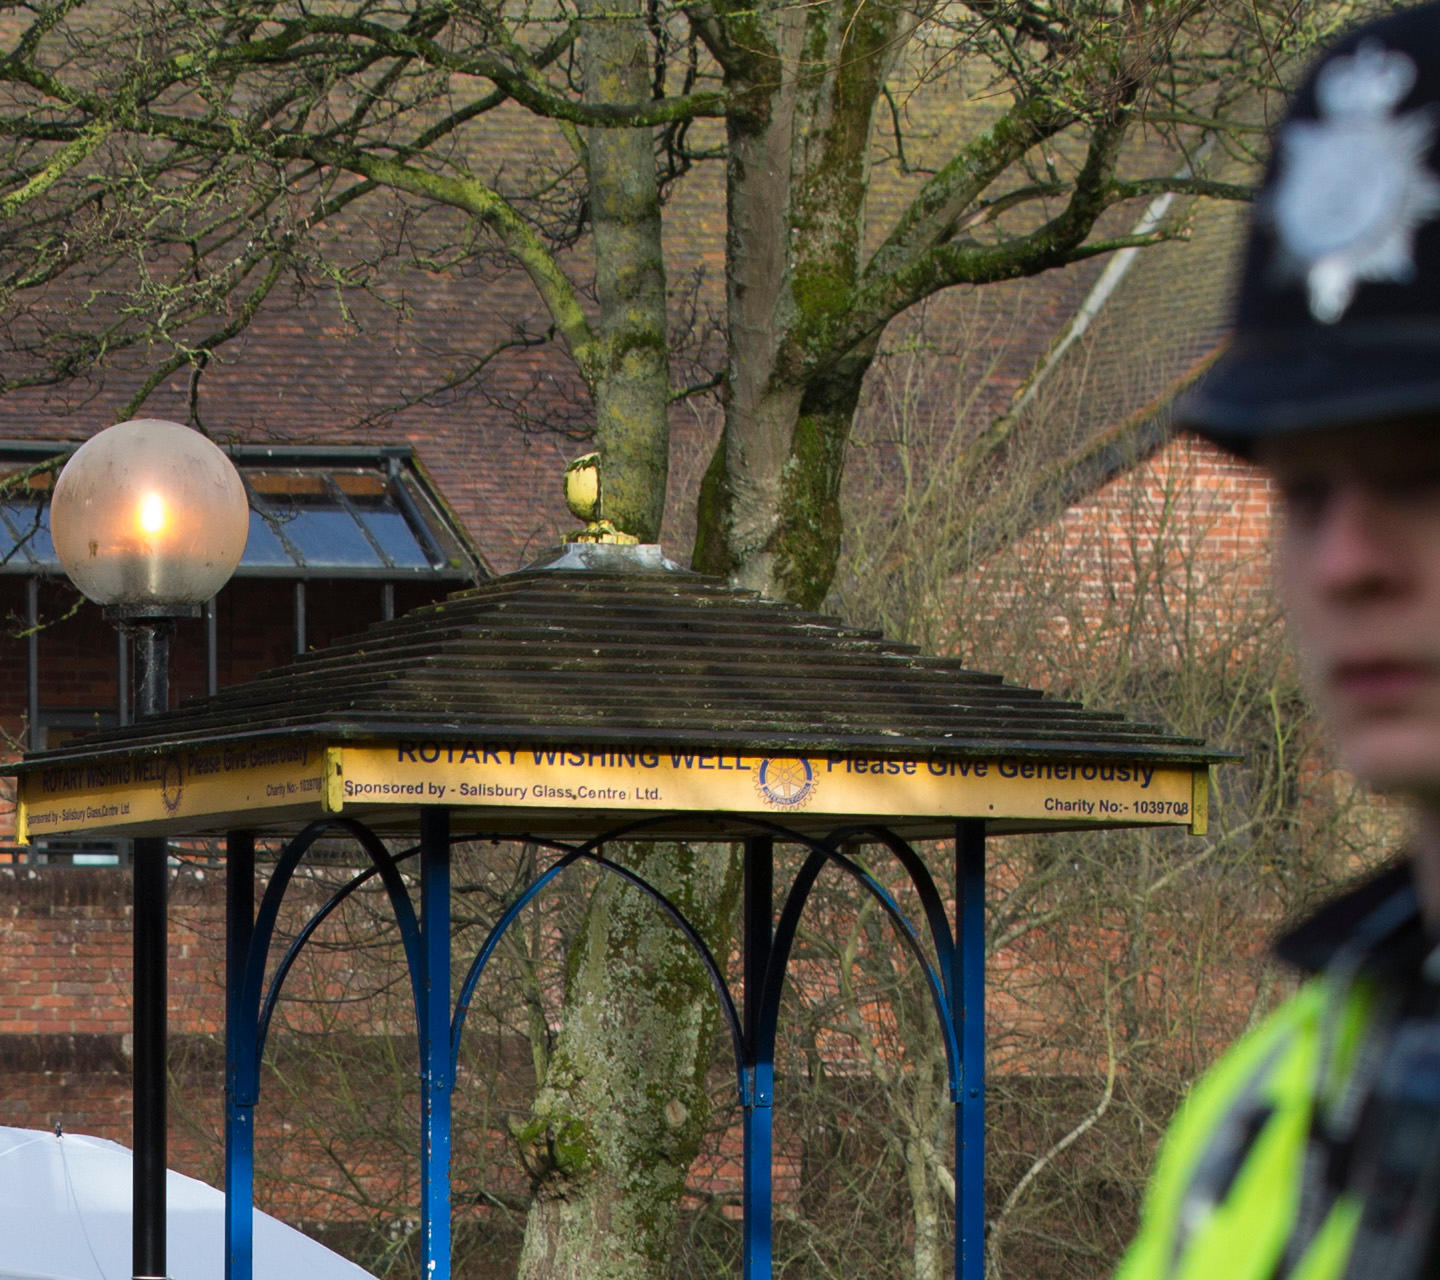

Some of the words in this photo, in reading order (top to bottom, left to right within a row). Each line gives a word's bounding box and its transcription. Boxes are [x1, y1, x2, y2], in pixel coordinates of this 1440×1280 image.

[398, 743, 519, 765] ROTARY
[531, 744, 659, 768] WISHING
[671, 747, 751, 770] WELL
[826, 751, 917, 775] Please
[927, 753, 988, 777] Give
[998, 755, 1155, 788] Generously
[344, 780, 424, 796] Sponsored
[428, 783, 446, 799] by
[459, 783, 527, 800] Salisbury
[1044, 798, 1095, 815] Charity
